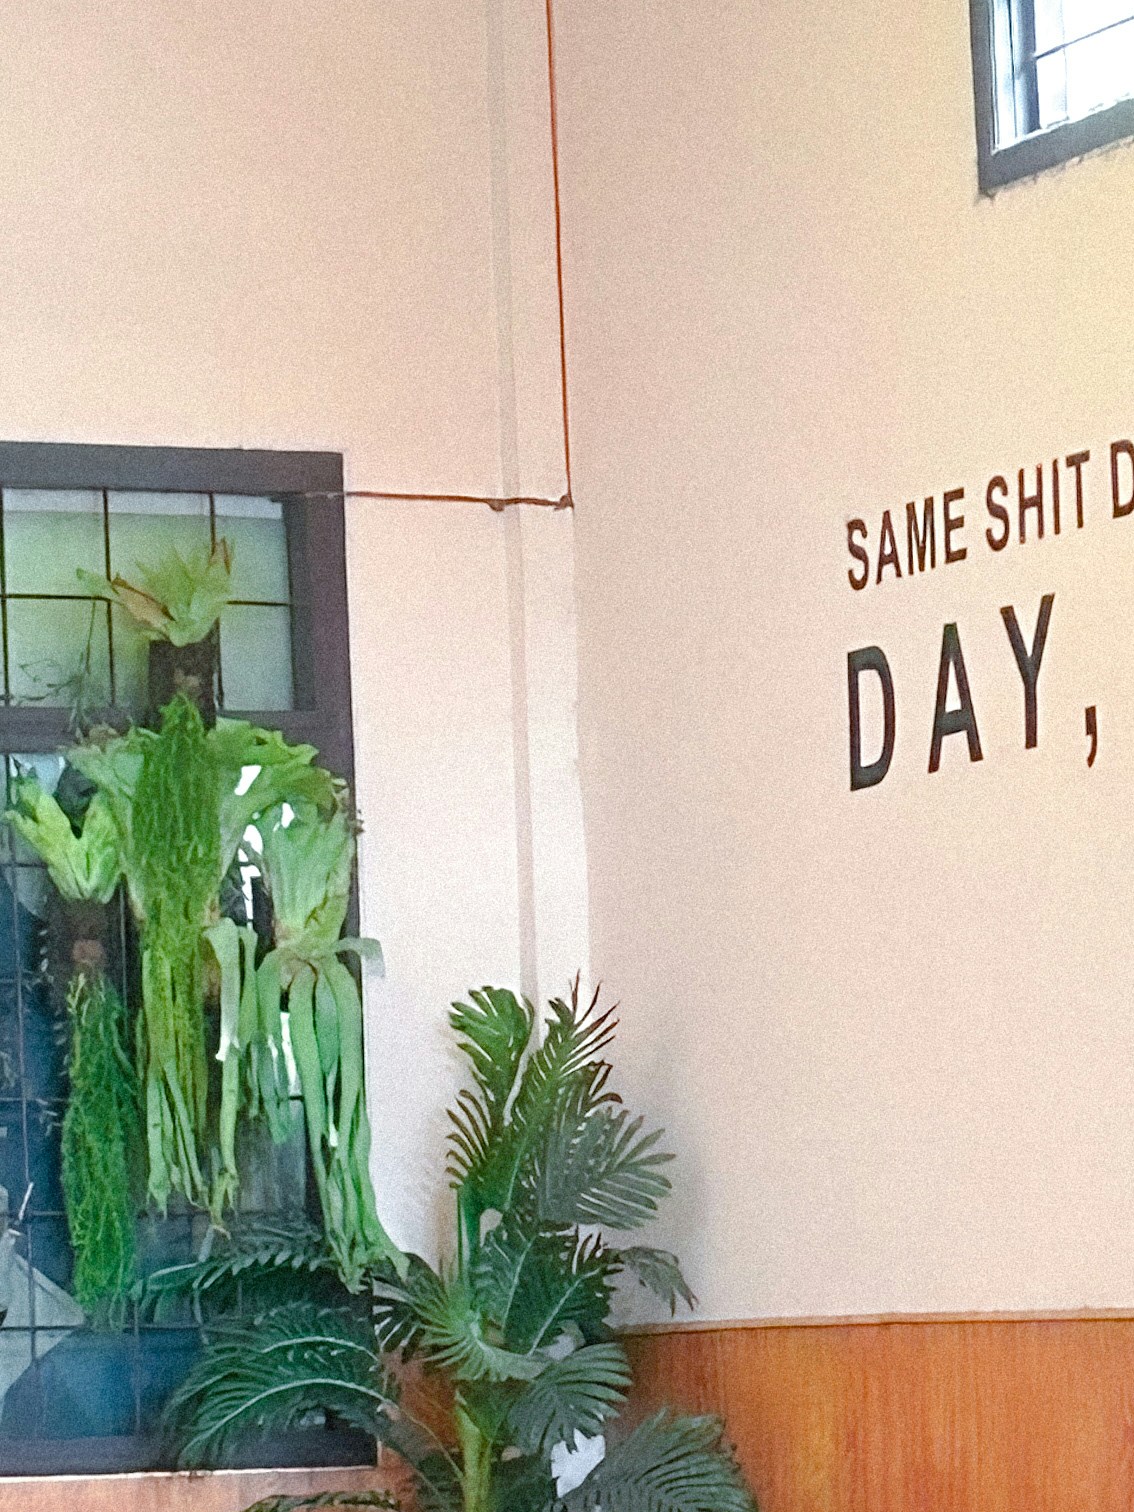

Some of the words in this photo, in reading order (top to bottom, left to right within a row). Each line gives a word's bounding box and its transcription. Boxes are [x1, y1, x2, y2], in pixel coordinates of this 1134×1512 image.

[846, 487, 968, 592] SAME
[985, 450, 1091, 552] SHIT
[846, 593, 1099, 792] DAY,
